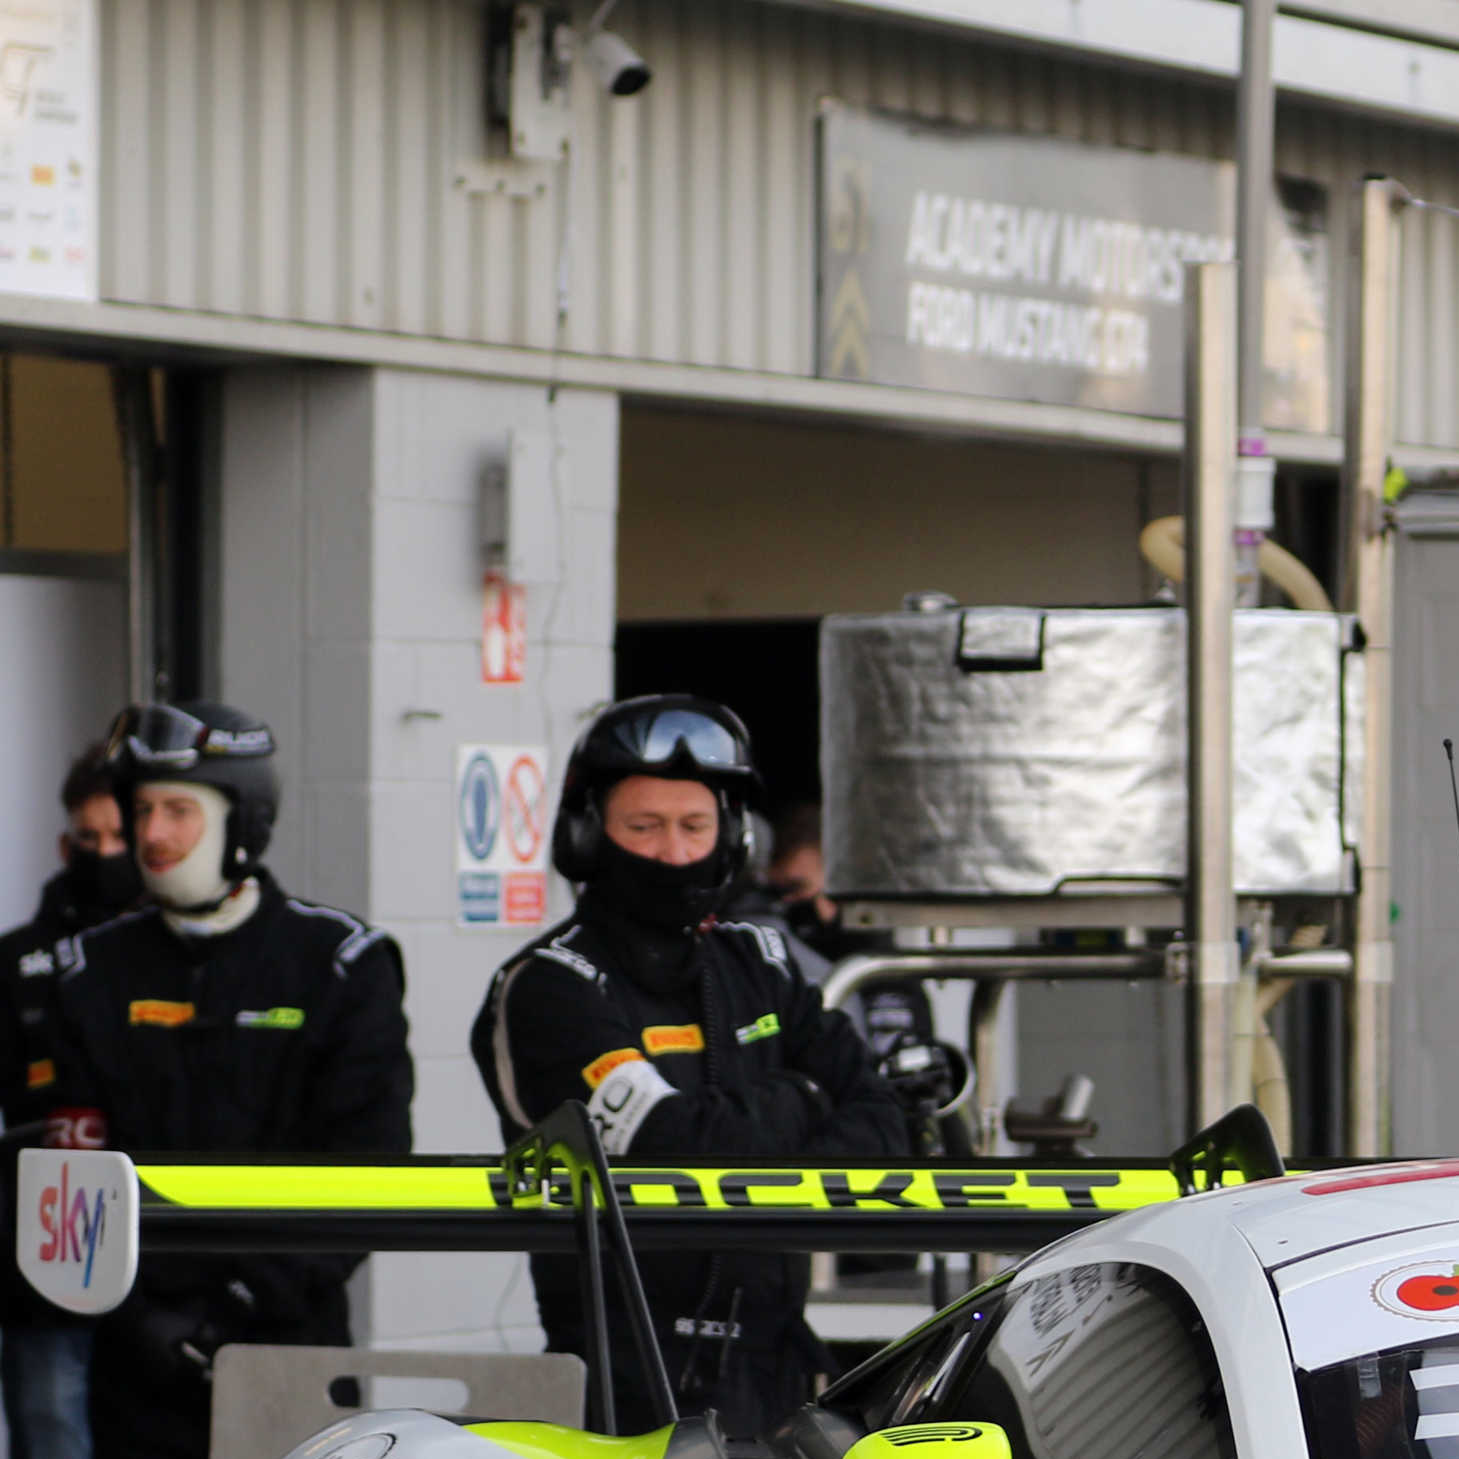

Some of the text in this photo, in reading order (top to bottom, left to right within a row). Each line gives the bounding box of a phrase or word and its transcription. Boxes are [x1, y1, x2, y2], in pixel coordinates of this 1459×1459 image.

[904, 190, 1060, 284] ACADEMY
[905, 281, 974, 353] FORD
[38, 1161, 105, 1289] sky
